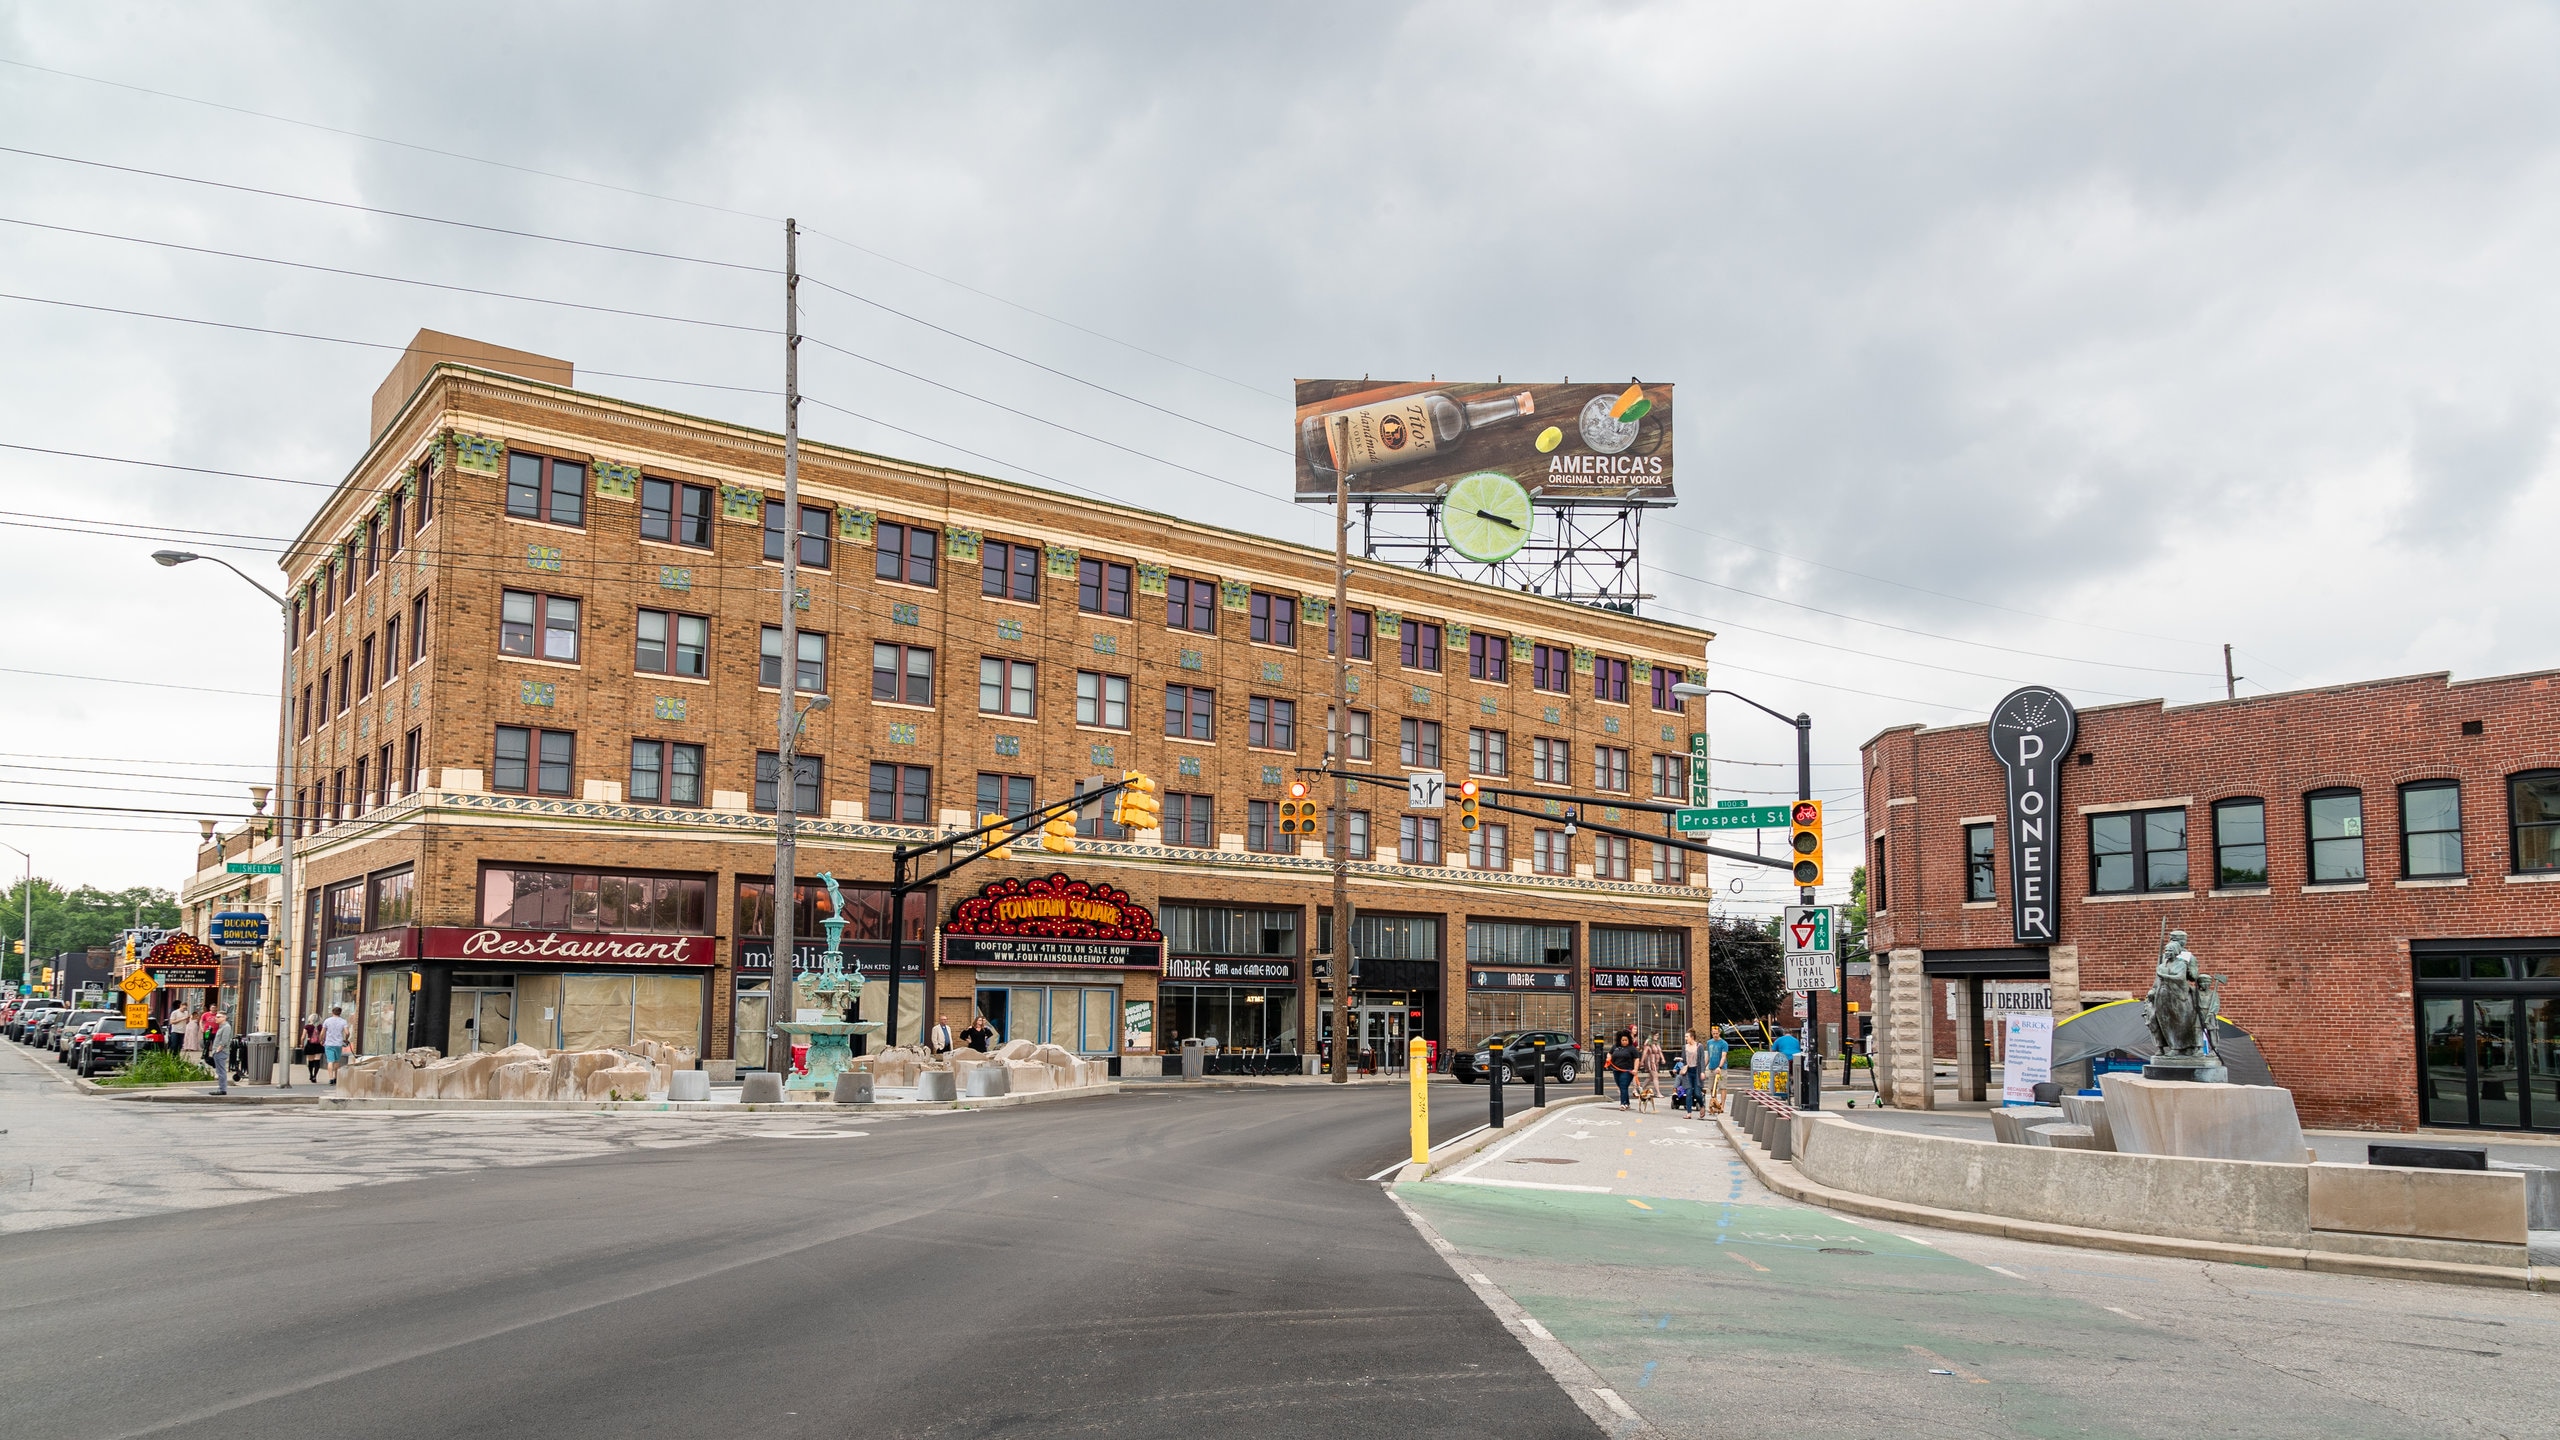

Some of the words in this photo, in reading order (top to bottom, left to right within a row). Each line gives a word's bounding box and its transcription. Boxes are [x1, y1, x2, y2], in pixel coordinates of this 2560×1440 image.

[1407, 405, 1430, 449] Tito's
[1360, 411, 1383, 463] Handmade
[1548, 455, 1663, 474] AMERICA'S
[1548, 474, 1595, 484] ORIGINAL
[1596, 475, 1628, 485] CRAFT
[1629, 475, 1663, 485] VODKA
[1682, 812, 1757, 826] Prospect
[1767, 811, 1785, 823] St
[2019, 734, 2052, 938] PIONEER
[242, 864, 272, 873] SHELBY
[999, 899, 1066, 921] FOUNTAIN
[1069, 900, 1120, 926] SQUARE
[224, 919, 259, 928] DUCKPIN
[223, 930, 258, 939] BOWLING
[462, 930, 690, 962] Restaurant
[975, 941, 1013, 952] ROOFTOP
[1016, 943, 1036, 952] JULY
[1040, 944, 1056, 953] 4TH
[1059, 945, 1072, 954] TIX
[1075, 946, 1086, 954] ON
[1088, 945, 1107, 955] SALE
[1109, 946, 1130, 956] NOW!
[994, 951, 1125, 965] WWW.FOUNTAINSQUAREINDY.COM
[1789, 957, 1815, 967] YIELD
[1820, 955, 1831, 965] TO
[907, 964, 920, 972] BAR
[1214, 963, 1229, 976] BAR
[1230, 967, 1243, 976] and
[1243, 964, 1265, 976] GAME
[1265, 965, 1289, 977] ROOM
[1797, 967, 1824, 977] TRAIL
[1595, 973, 1613, 987] PIZZA
[1616, 974, 1630, 987] BBQ
[1632, 975, 1649, 988] BEER
[1651, 975, 1683, 989] COCKTAILS
[1797, 978, 1825, 988] USERS
